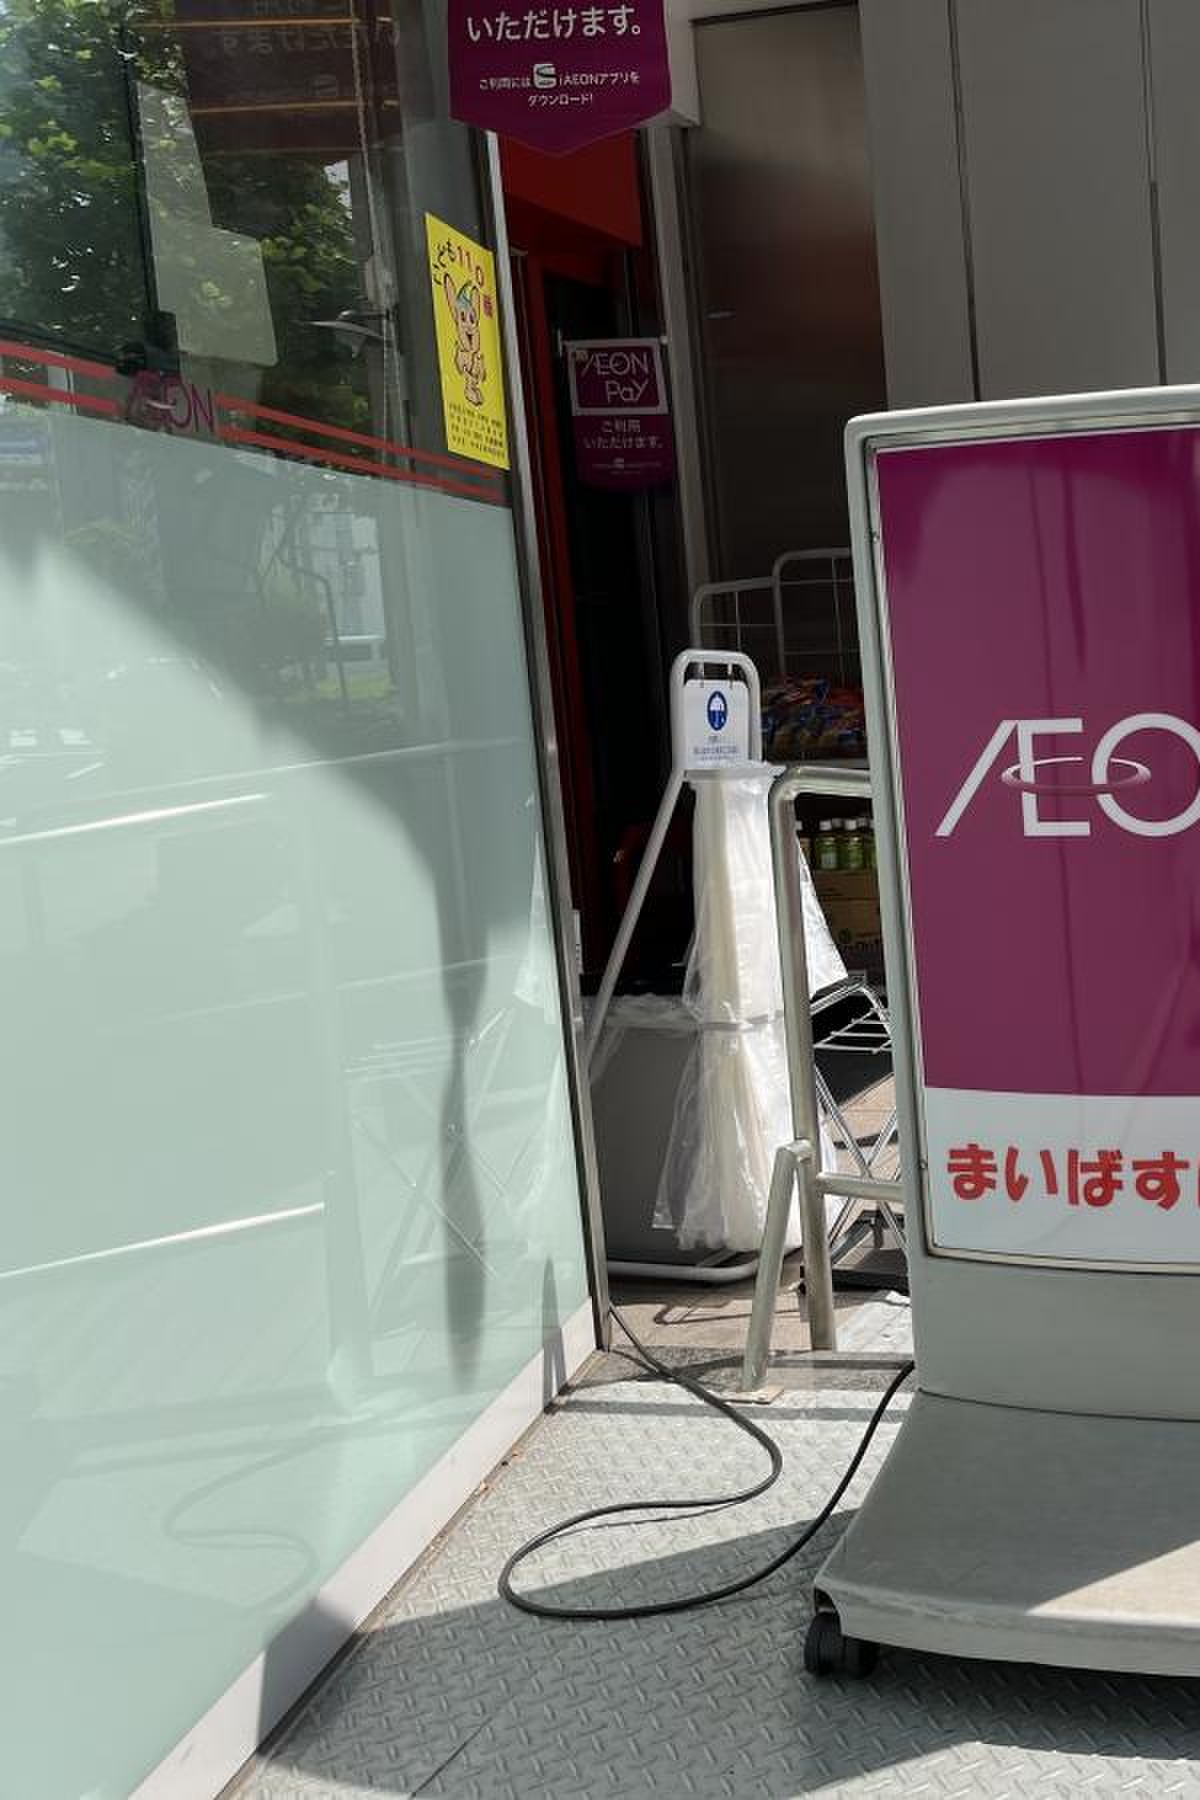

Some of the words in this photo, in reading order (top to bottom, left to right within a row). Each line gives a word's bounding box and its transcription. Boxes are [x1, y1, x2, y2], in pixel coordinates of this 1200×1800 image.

[467, 5, 640, 41] いただけます。
[580, 352, 650, 377] AEON
